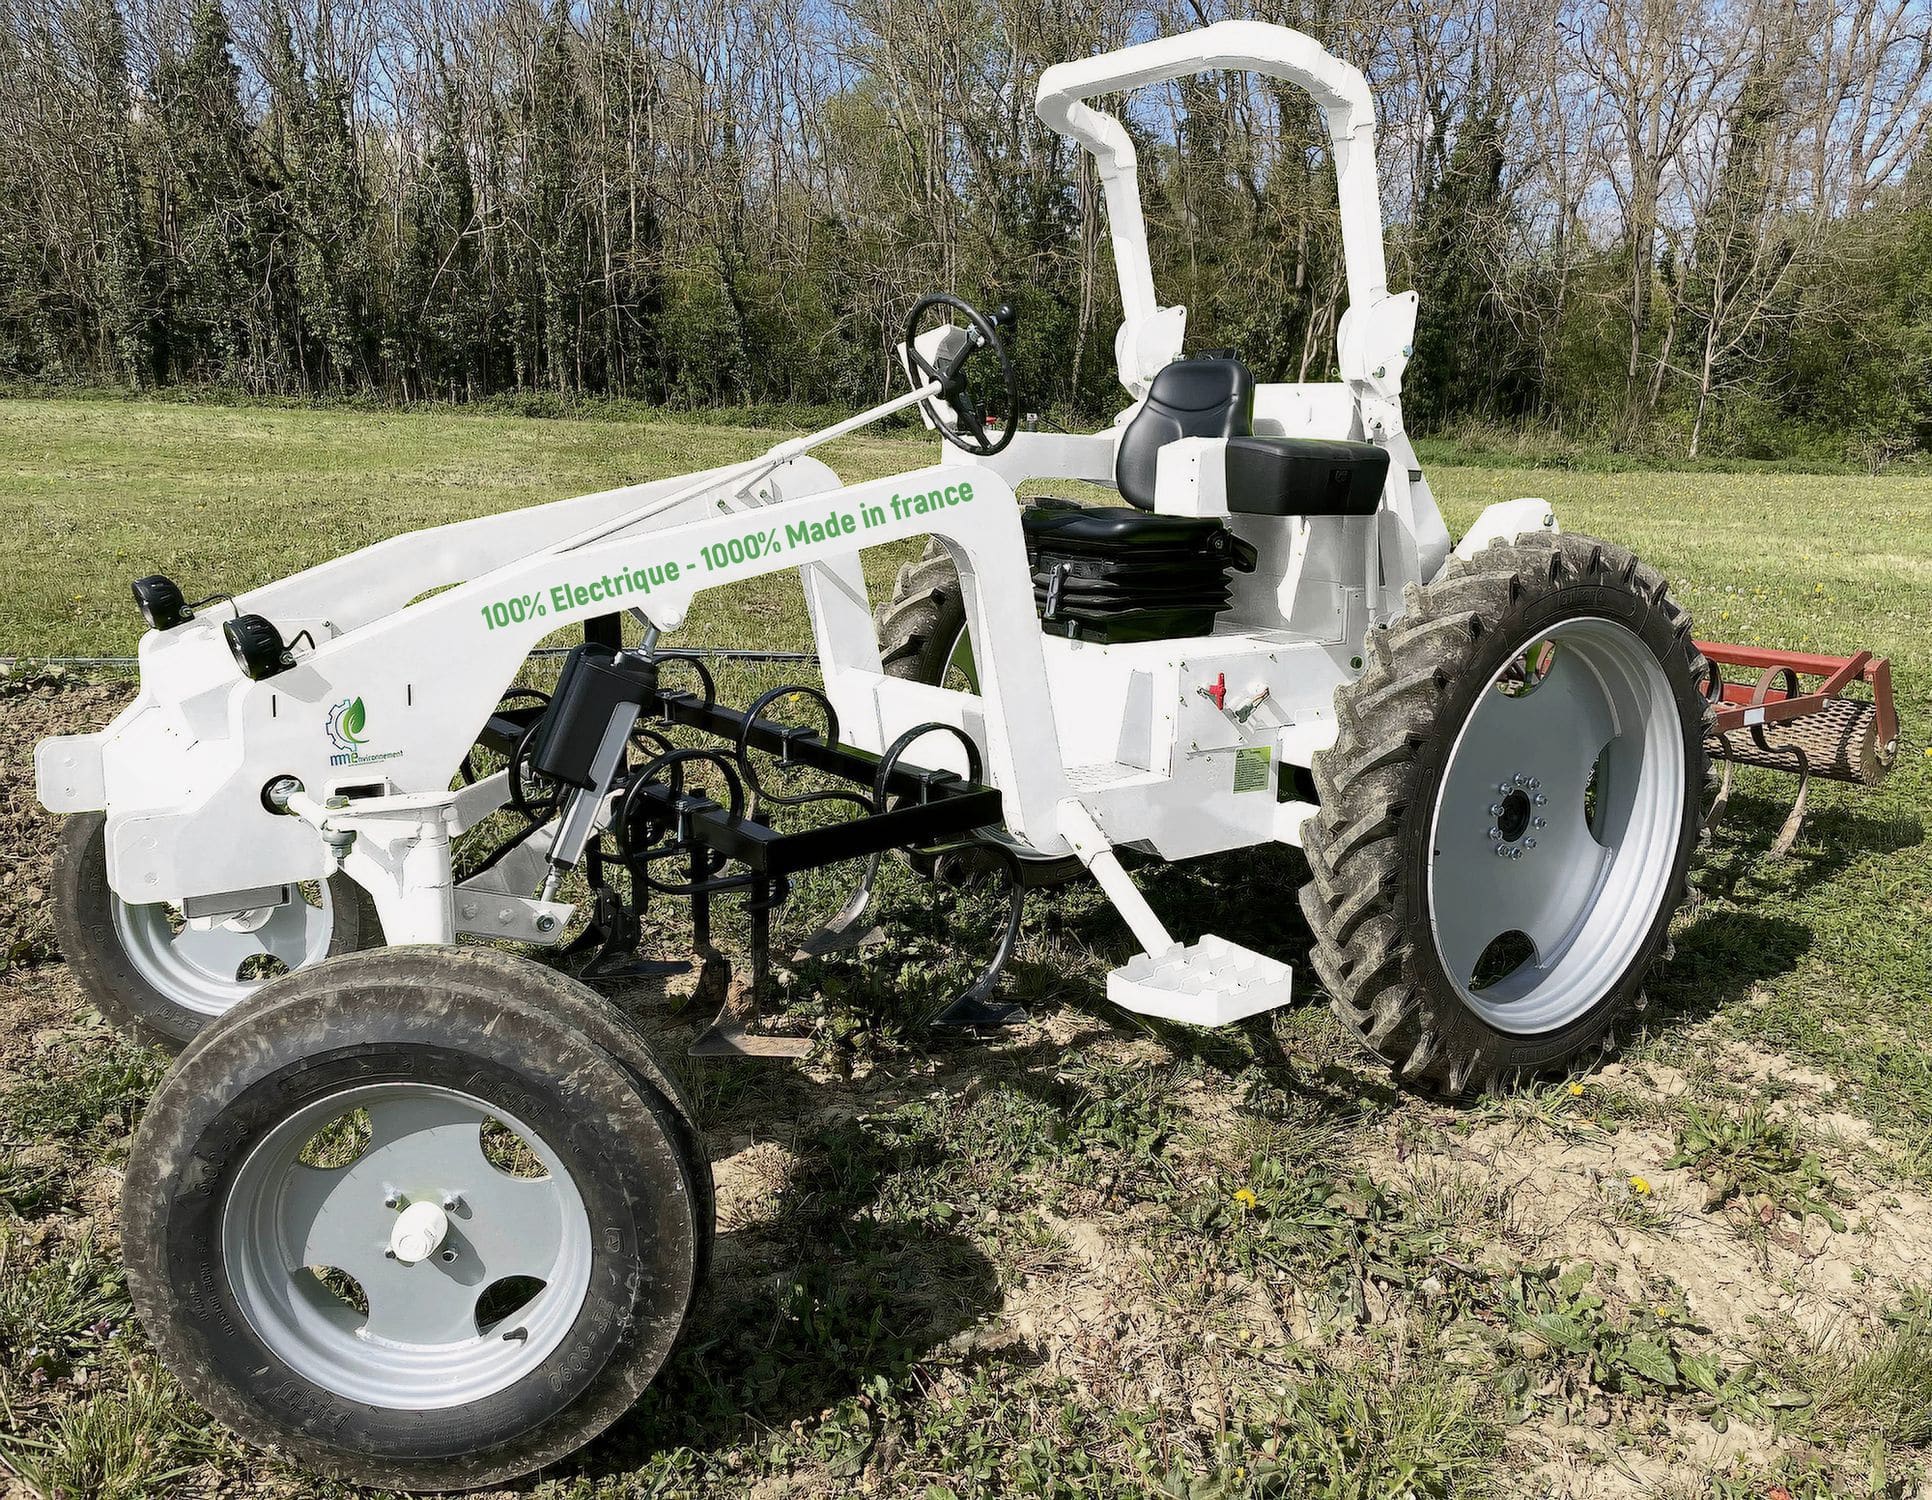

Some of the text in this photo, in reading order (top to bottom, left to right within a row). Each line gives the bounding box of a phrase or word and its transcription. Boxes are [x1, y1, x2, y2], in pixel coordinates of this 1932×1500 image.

[481, 592, 547, 630] 100%
[550, 560, 681, 612] Electrique
[700, 529, 781, 572] 1000%
[785, 511, 856, 548] Made
[861, 501, 886, 529] in
[891, 482, 974, 520] france
